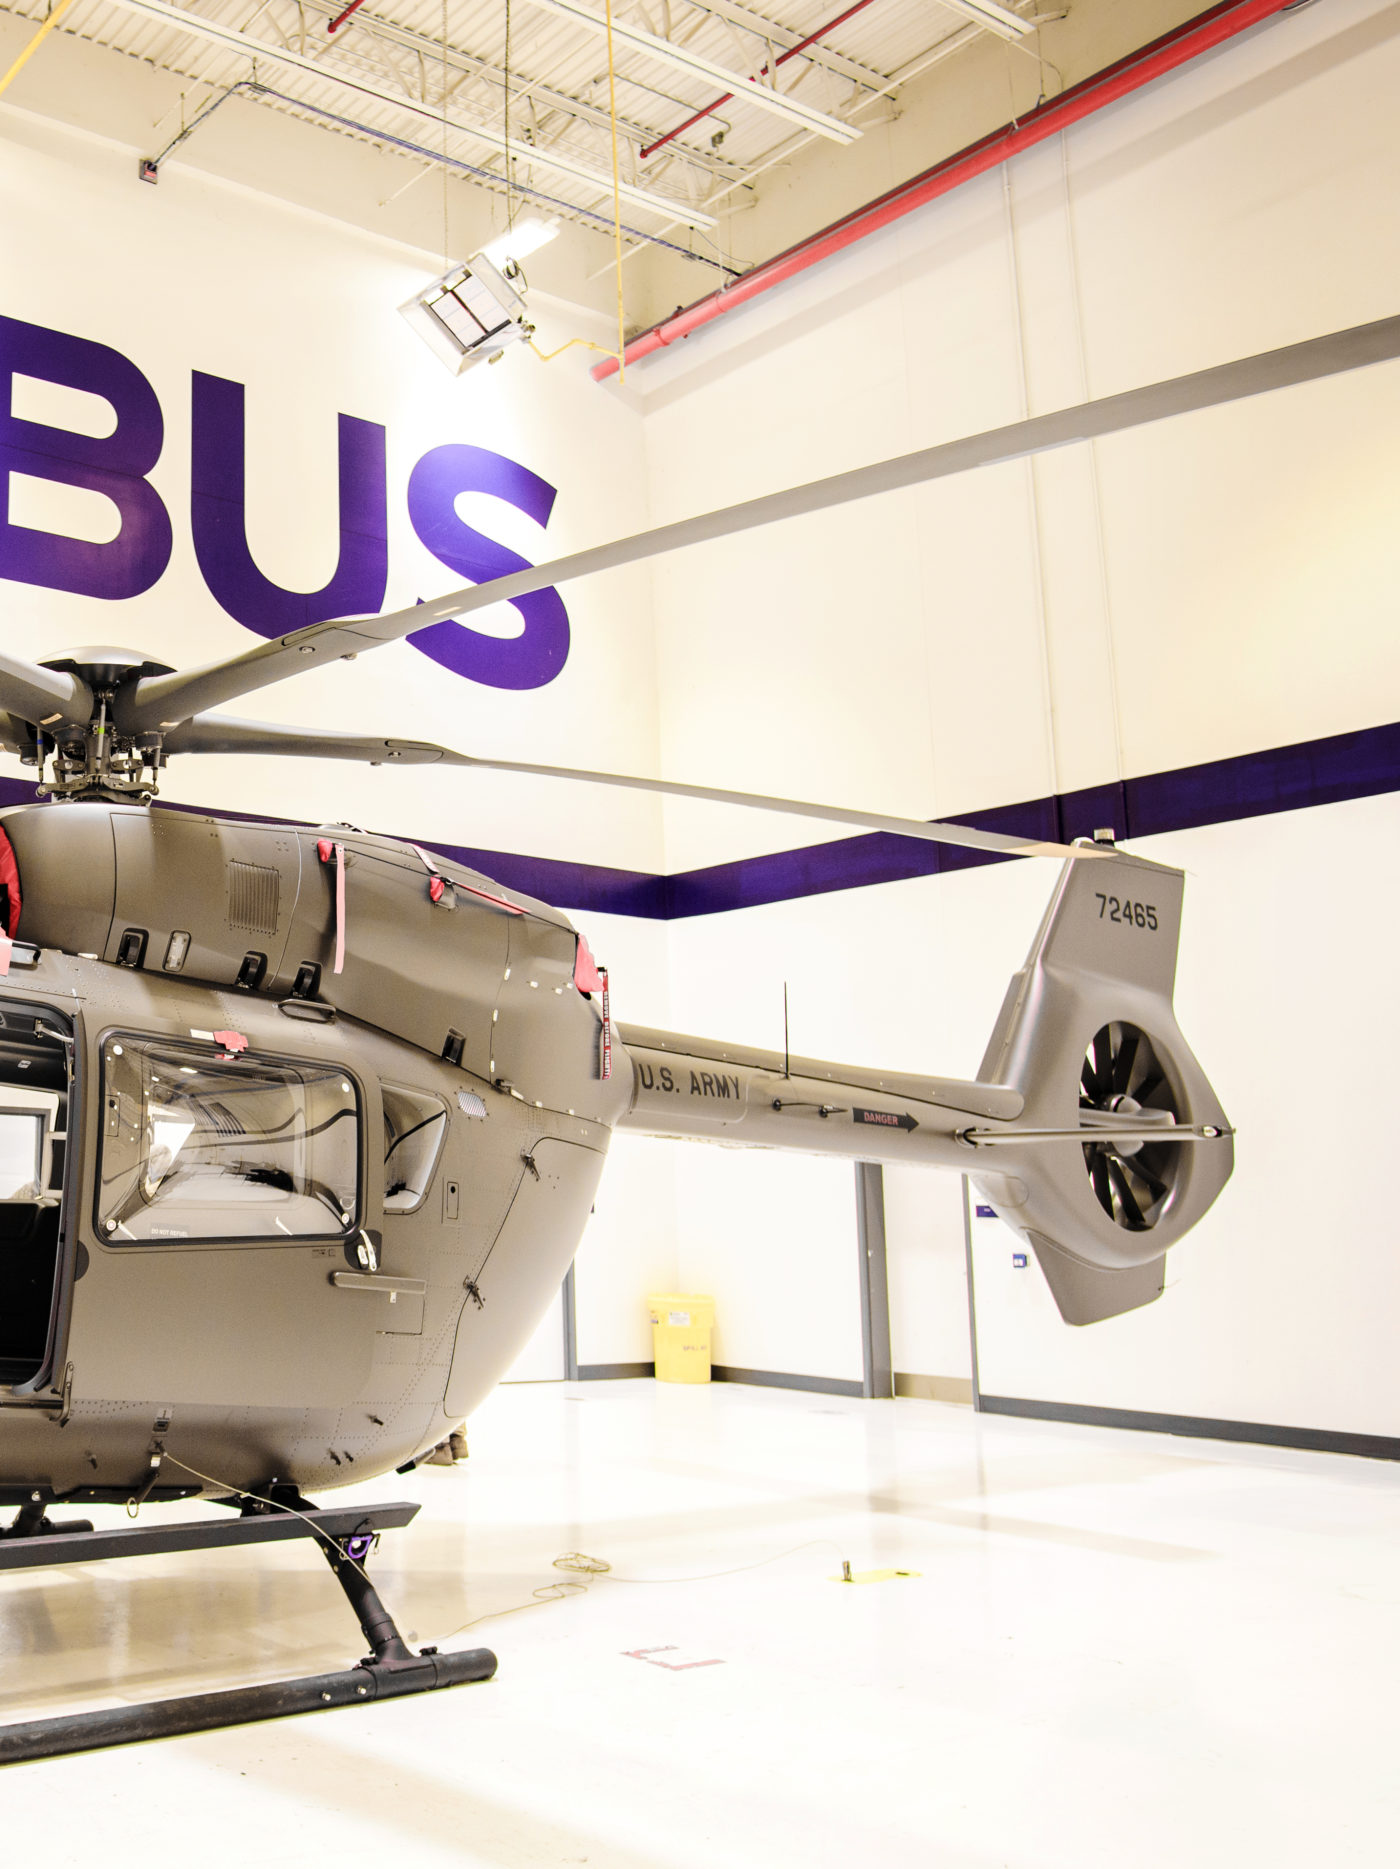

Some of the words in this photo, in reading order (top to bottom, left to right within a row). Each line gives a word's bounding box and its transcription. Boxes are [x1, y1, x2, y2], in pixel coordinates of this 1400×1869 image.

[1095, 892, 1158, 931] 72465
[638, 1063, 680, 1093] U.S.
[689, 1070, 740, 1100] ARMY
[864, 1111, 899, 1126] DANGER
